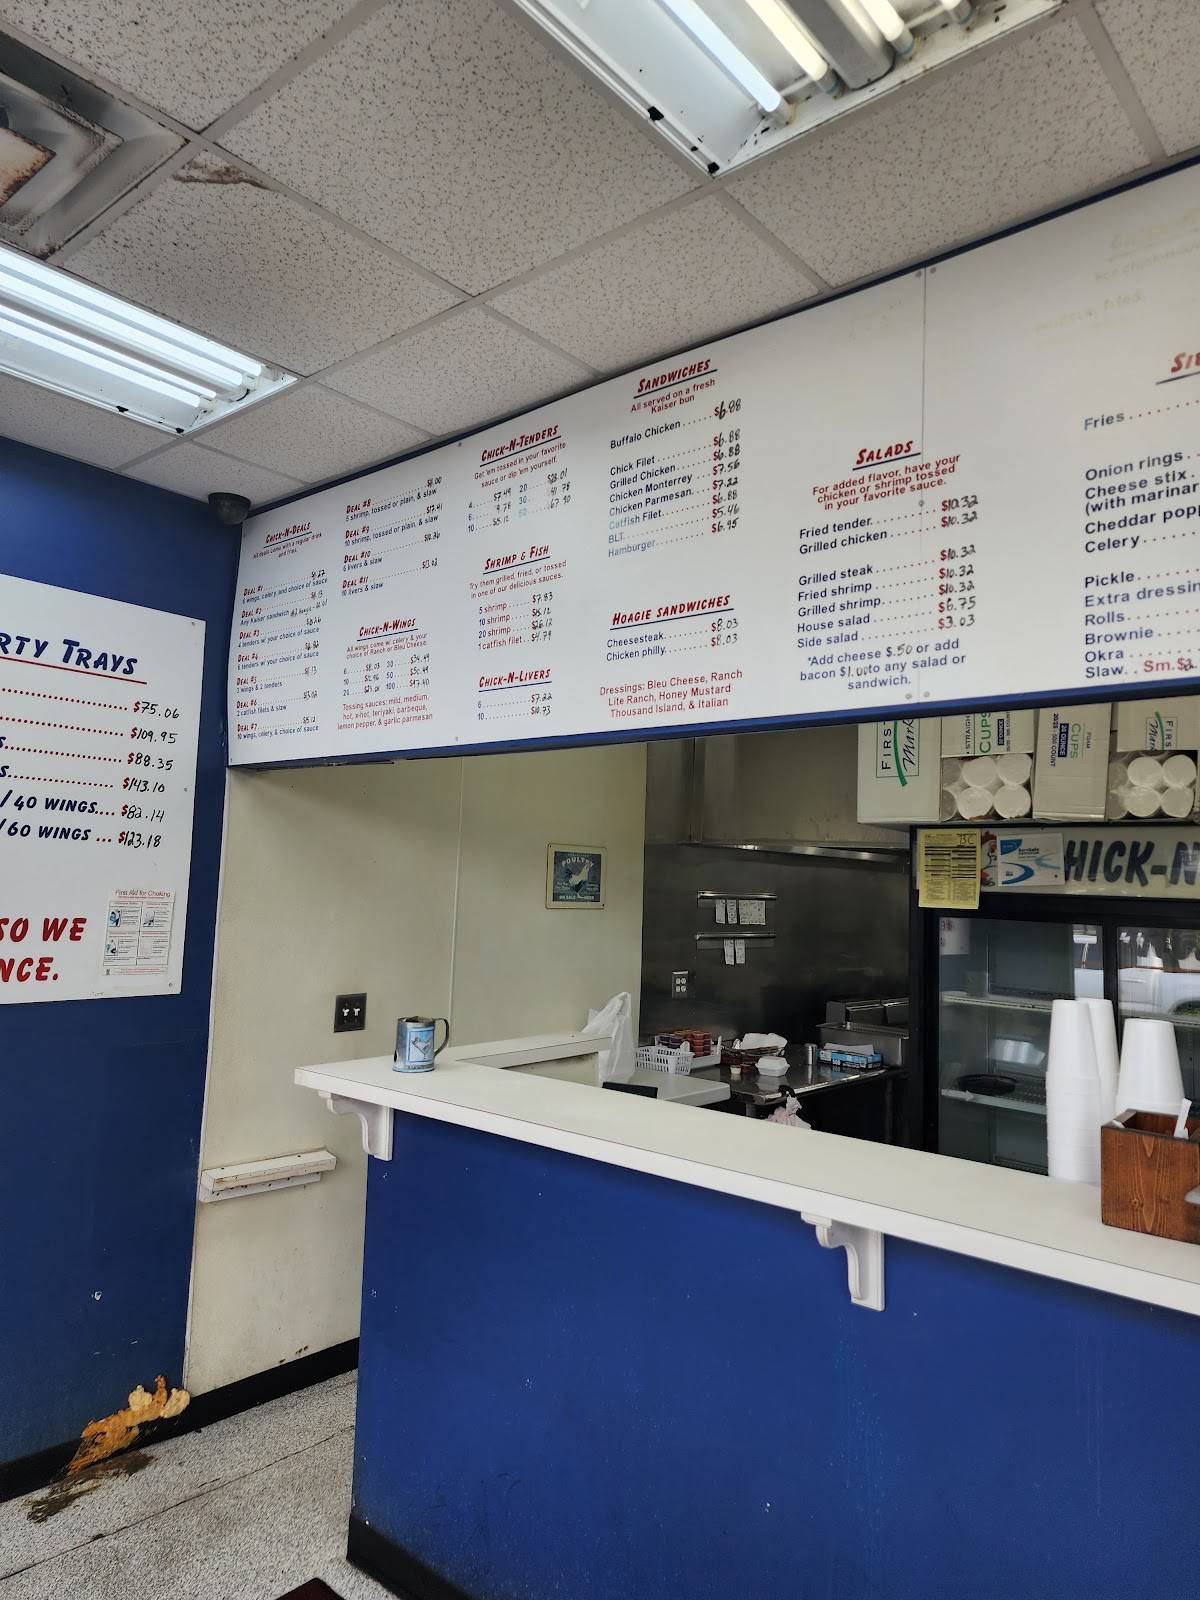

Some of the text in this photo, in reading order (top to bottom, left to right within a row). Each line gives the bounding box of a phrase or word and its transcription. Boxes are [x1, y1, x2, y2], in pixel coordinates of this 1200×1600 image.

[637, 359, 711, 393] SANDWICHES
[631, 403, 642, 412] All
[643, 394, 671, 408] served
[673, 389, 683, 398] on
[693, 379, 715, 392] fresh
[651, 393, 694, 414] Kaiser bun
[610, 398, 741, 449] Buffalo Chicken $6.88
[1084, 412, 1125, 430] Fries
[481, 425, 558, 461] CHICK-N-TENDERS
[610, 429, 740, 476] Chick Filet $6.88
[856, 441, 914, 465] SALADS
[610, 444, 740, 489] Grilled Chicken $6.88
[813, 454, 960, 496] For added flavor, have your
[1085, 452, 1183, 481] Onion rings
[610, 486, 643, 503] Chicken
[645, 474, 692, 493] Monterrey
[817, 464, 955, 503] chicken or shrimp tossed
[825, 478, 946, 511] in your favorite sauce.
[1085, 470, 1186, 499] Cheese stix
[609, 477, 738, 516] Chicken Parmesan $7.22
[1085, 496, 1125, 516] (with
[608, 504, 740, 544] BLT $5.46
[609, 515, 640, 530] Catfish
[642, 509, 662, 521] Filet
[800, 522, 829, 539] Fried
[832, 517, 871, 533] tender
[1085, 513, 1156, 534] Cheddar
[608, 518, 738, 557] Hamburger $6.95
[800, 511, 978, 555] Grilled chicken $10.32
[1085, 536, 1140, 553] Celery
[485, 545, 549, 570] SHRIMP & FISH
[799, 545, 976, 586] Grilled steak $10.32
[798, 564, 974, 601] Fried shrimp $10.32
[1085, 571, 1135, 588] Pickle
[612, 595, 730, 625] HOAGIE SANDWICHES
[798, 581, 975, 617] Grilled shrimp $10.32
[1085, 592, 1130, 607] Extra
[487, 614, 510, 625] shrimp
[797, 596, 976, 633] House salad $6.75
[1085, 612, 1125, 626] Rolls
[359, 618, 416, 638] CHICK-N-WINGS
[488, 626, 511, 637] shrimp
[607, 618, 738, 647] Cheesesteak $8.03
[798, 615, 975, 649] Side salad $3.03
[1085, 627, 1153, 645] Brownie
[62, 639, 138, 674] TRAYS
[606, 633, 738, 661] Chicken philly $8.03
[837, 650, 881, 664] cheese
[916, 644, 929, 653] or
[934, 638, 959, 651] add
[1085, 650, 1124, 662] Okra
[479, 669, 550, 688] CHICK-N-LIVERS
[600, 670, 742, 695] Dressings: Bleu Cheese, Ranch
[848, 676, 911, 690] sandwich.
[1085, 666, 1123, 678] Slaw
[609, 684, 731, 706] Lite Ranch, Honey Mustard
[134, 701, 179, 718] $75.06
[611, 698, 728, 718] Thousand Island, & Italian
[130, 727, 178, 743] $109.95
[128, 753, 174, 770] $88.35
[123, 777, 165, 792] $143.10
[14, 796, 165, 822] 40 WINGS $82.14
[8, 822, 161, 848] 60 WINGS $123.18
[42, 918, 87, 941] WE
